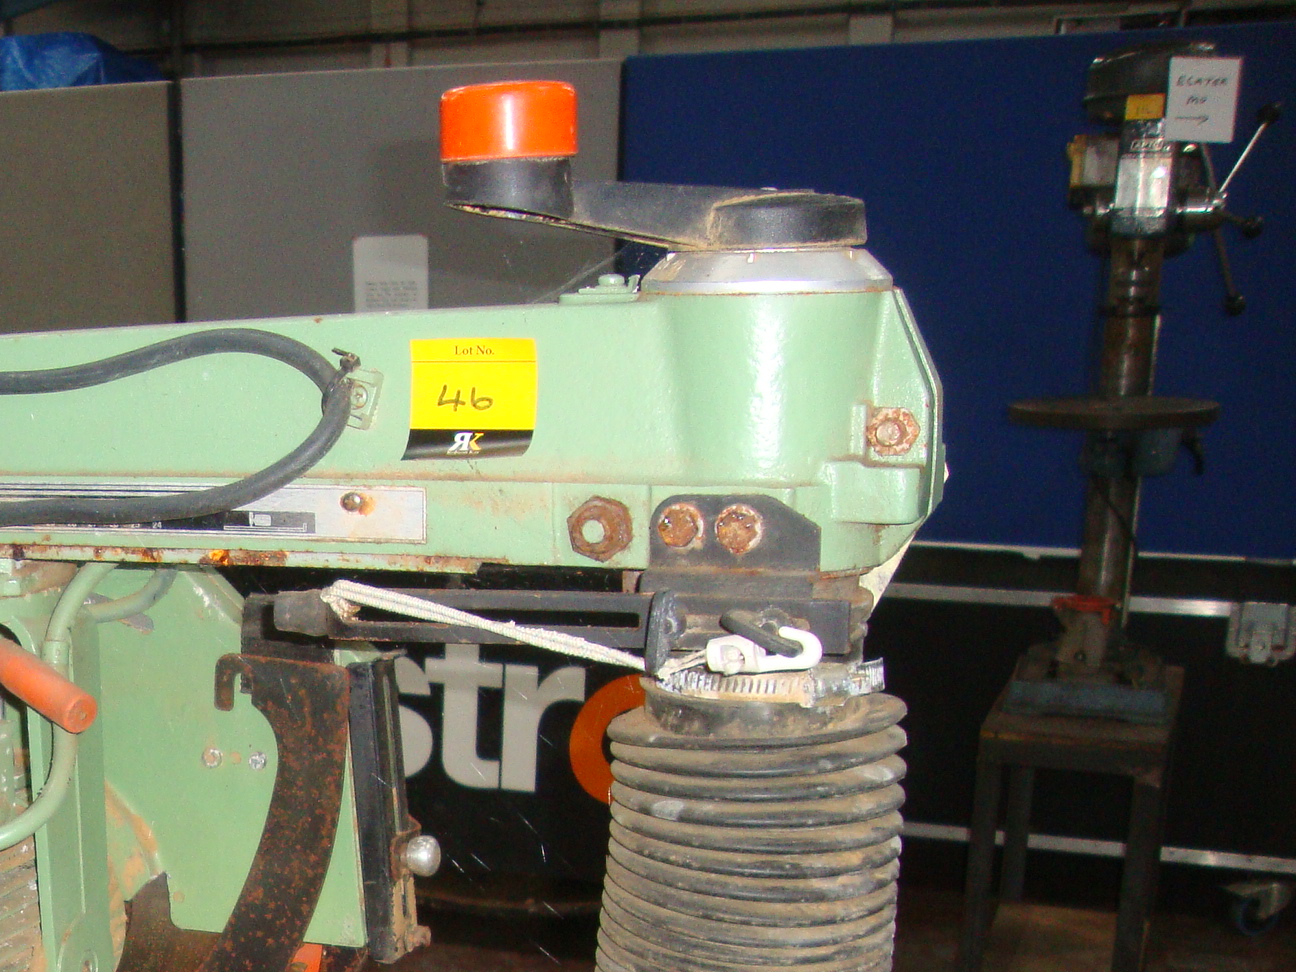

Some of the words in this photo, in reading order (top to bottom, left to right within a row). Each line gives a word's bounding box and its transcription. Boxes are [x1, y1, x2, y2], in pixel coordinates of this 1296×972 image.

[455, 345, 473, 356] Lot
[476, 345, 495, 356] No.
[437, 384, 494, 412] 46
